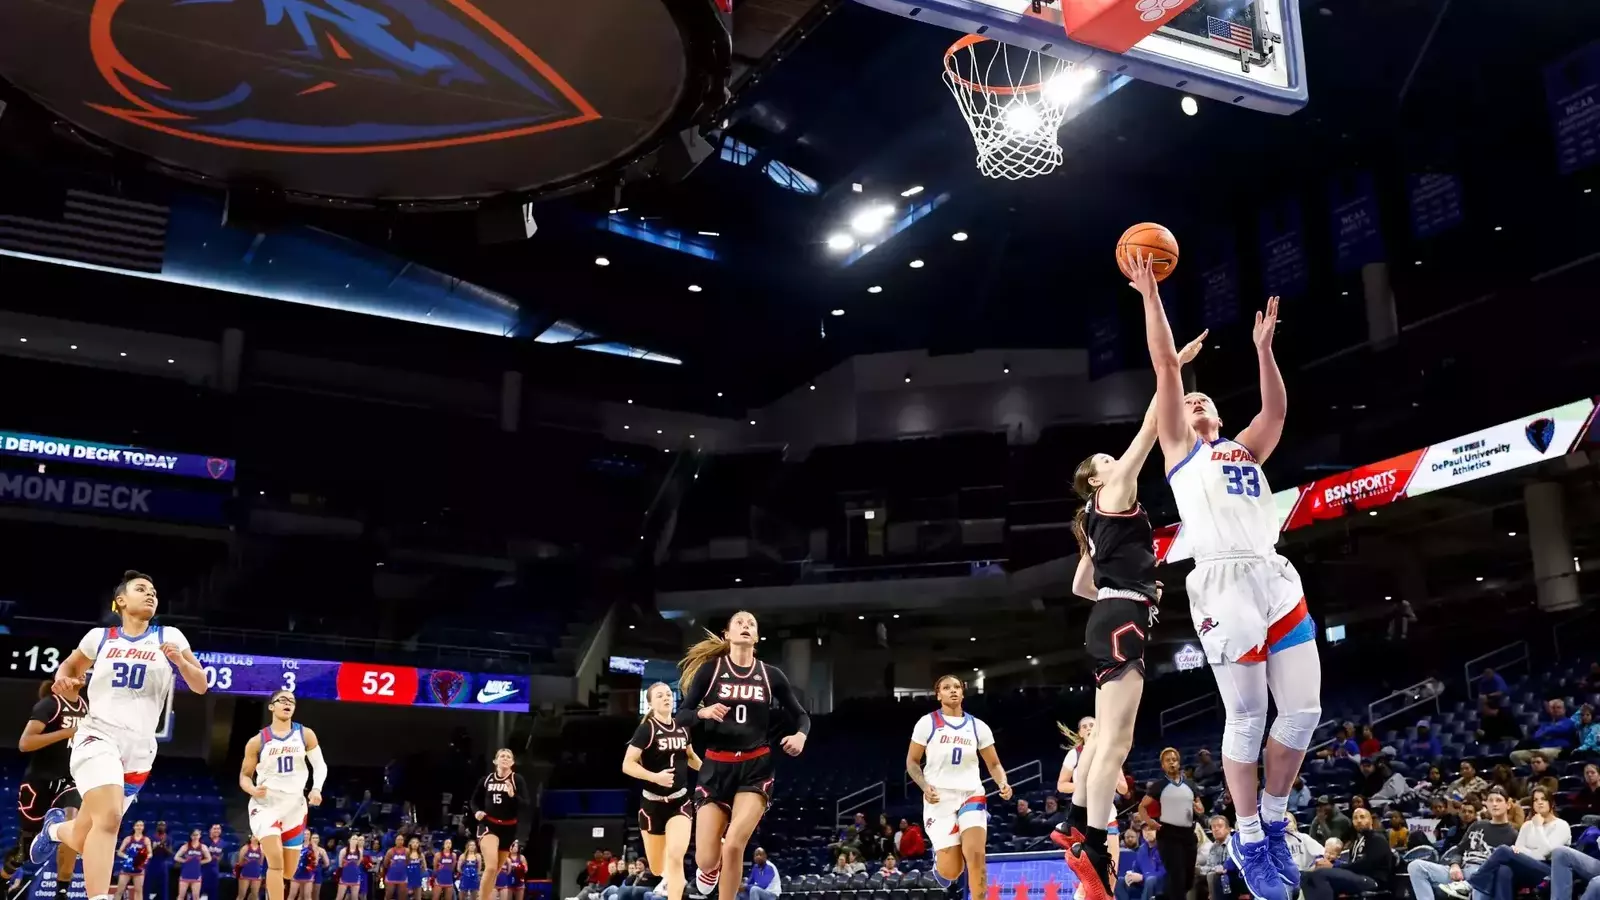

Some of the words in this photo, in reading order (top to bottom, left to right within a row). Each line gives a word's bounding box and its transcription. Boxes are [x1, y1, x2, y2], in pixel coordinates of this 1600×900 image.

[5, 437, 71, 457] DEMON
[73, 445, 121, 463] DECK
[122, 451, 178, 470] TODAY
[1464, 444, 1511, 462] University
[1452, 460, 1491, 476] Athletics
[1222, 465, 1260, 498] 33
[72, 481, 152, 513] DECK
[281, 659, 300, 669] TOL
[112, 662, 147, 689] 30
[281, 671, 297, 692] 3
[361, 671, 396, 696] 52
[719, 683, 765, 701] SIUE
[735, 704, 747, 724] 0
[658, 737, 687, 750] SIUE
[277, 755, 294, 773] 10
[952, 747, 962, 765] 0
[492, 793, 502, 804] 15
